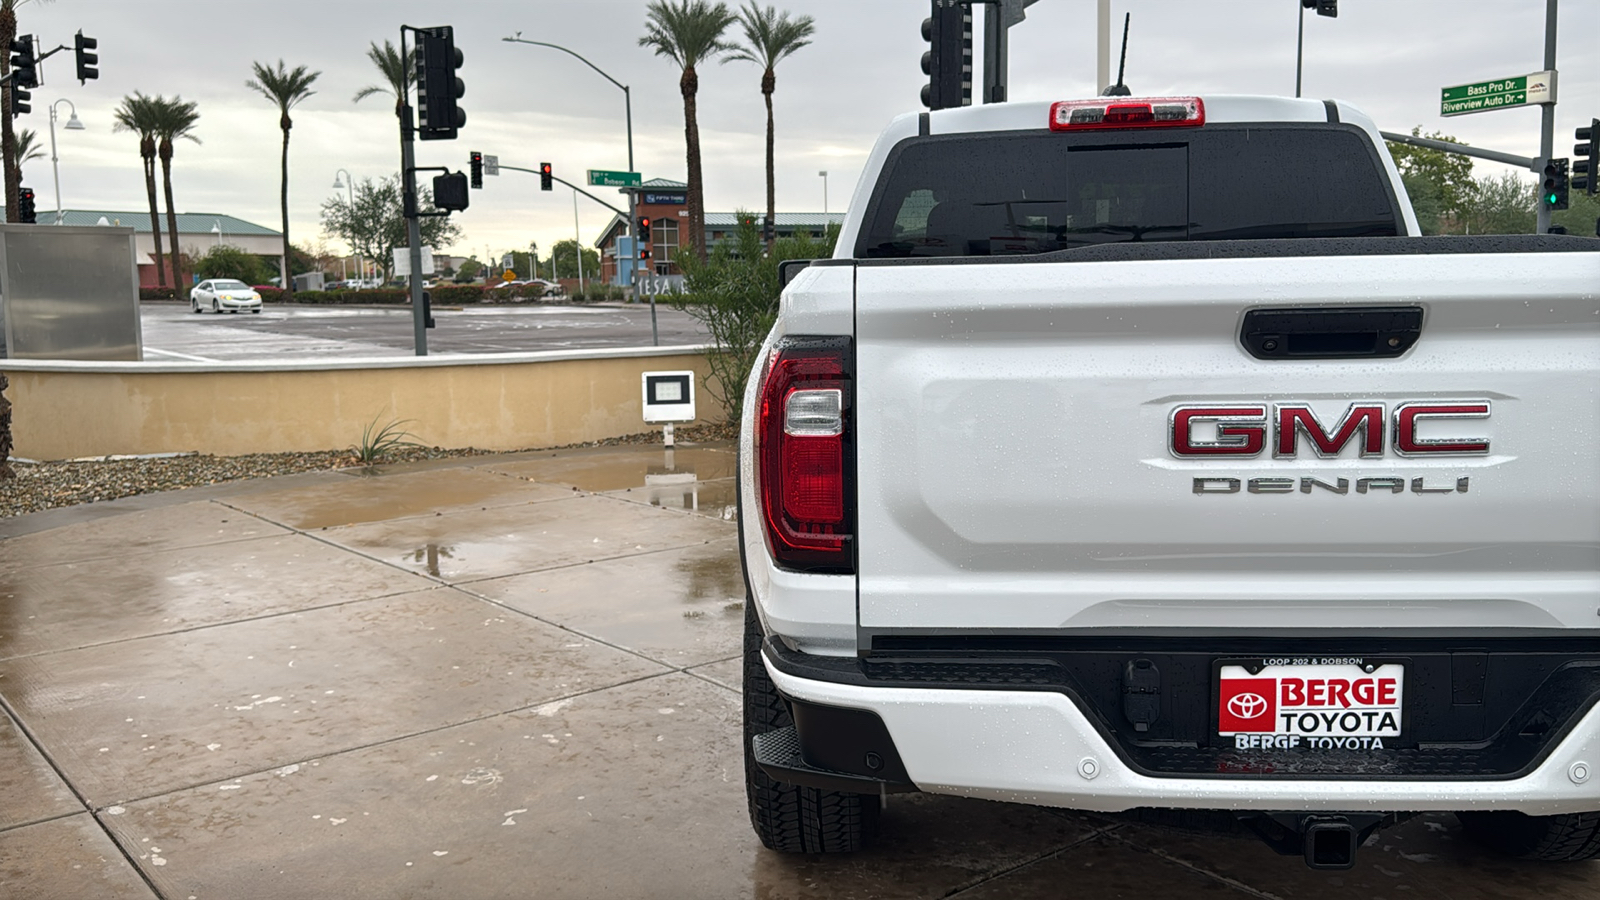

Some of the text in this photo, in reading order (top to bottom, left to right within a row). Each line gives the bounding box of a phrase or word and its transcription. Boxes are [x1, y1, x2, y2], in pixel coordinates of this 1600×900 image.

[1468, 80, 1517, 95] Bass Pro Dr.
[1443, 94, 1517, 113] Riverview Auto Dr.
[1166, 399, 1492, 460] GMC
[1191, 475, 1470, 495] DENALI
[1263, 658, 1290, 666] LOOP
[1292, 658, 1309, 666] 202
[1321, 657, 1363, 665] DOBSON
[1280, 677, 1397, 709] BERGE
[1280, 711, 1398, 732] TOYOTA
[1234, 733, 1384, 750] BERGE TOYOTA
